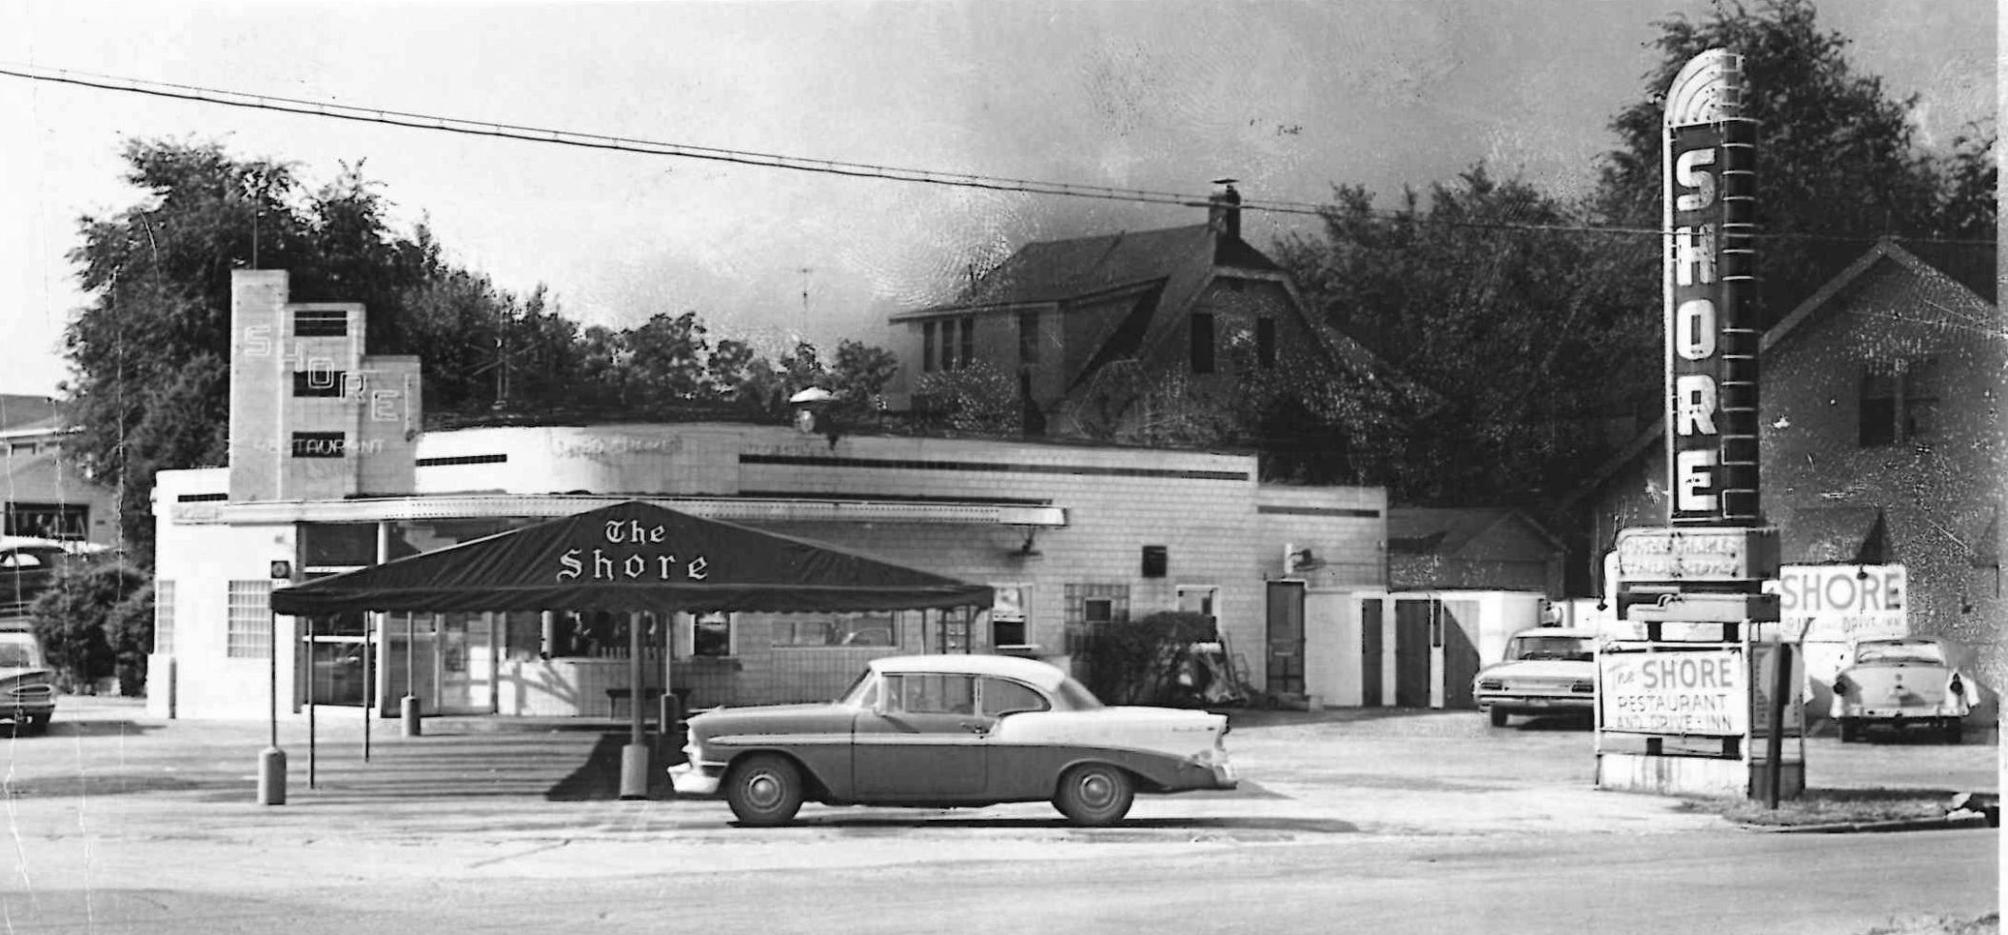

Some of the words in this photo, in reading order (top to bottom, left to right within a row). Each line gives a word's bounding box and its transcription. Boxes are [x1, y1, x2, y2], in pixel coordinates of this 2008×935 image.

[1676, 148, 1717, 512] SHORE
[245, 325, 399, 422] SHORE
[252, 438, 384, 455] TAURANT
[606, 520, 665, 543] The
[556, 549, 708, 581] Shore
[1781, 573, 1900, 611] SHORE
[1642, 657, 1733, 689] SHORE
[1617, 693, 1727, 712] RESTAURANT
